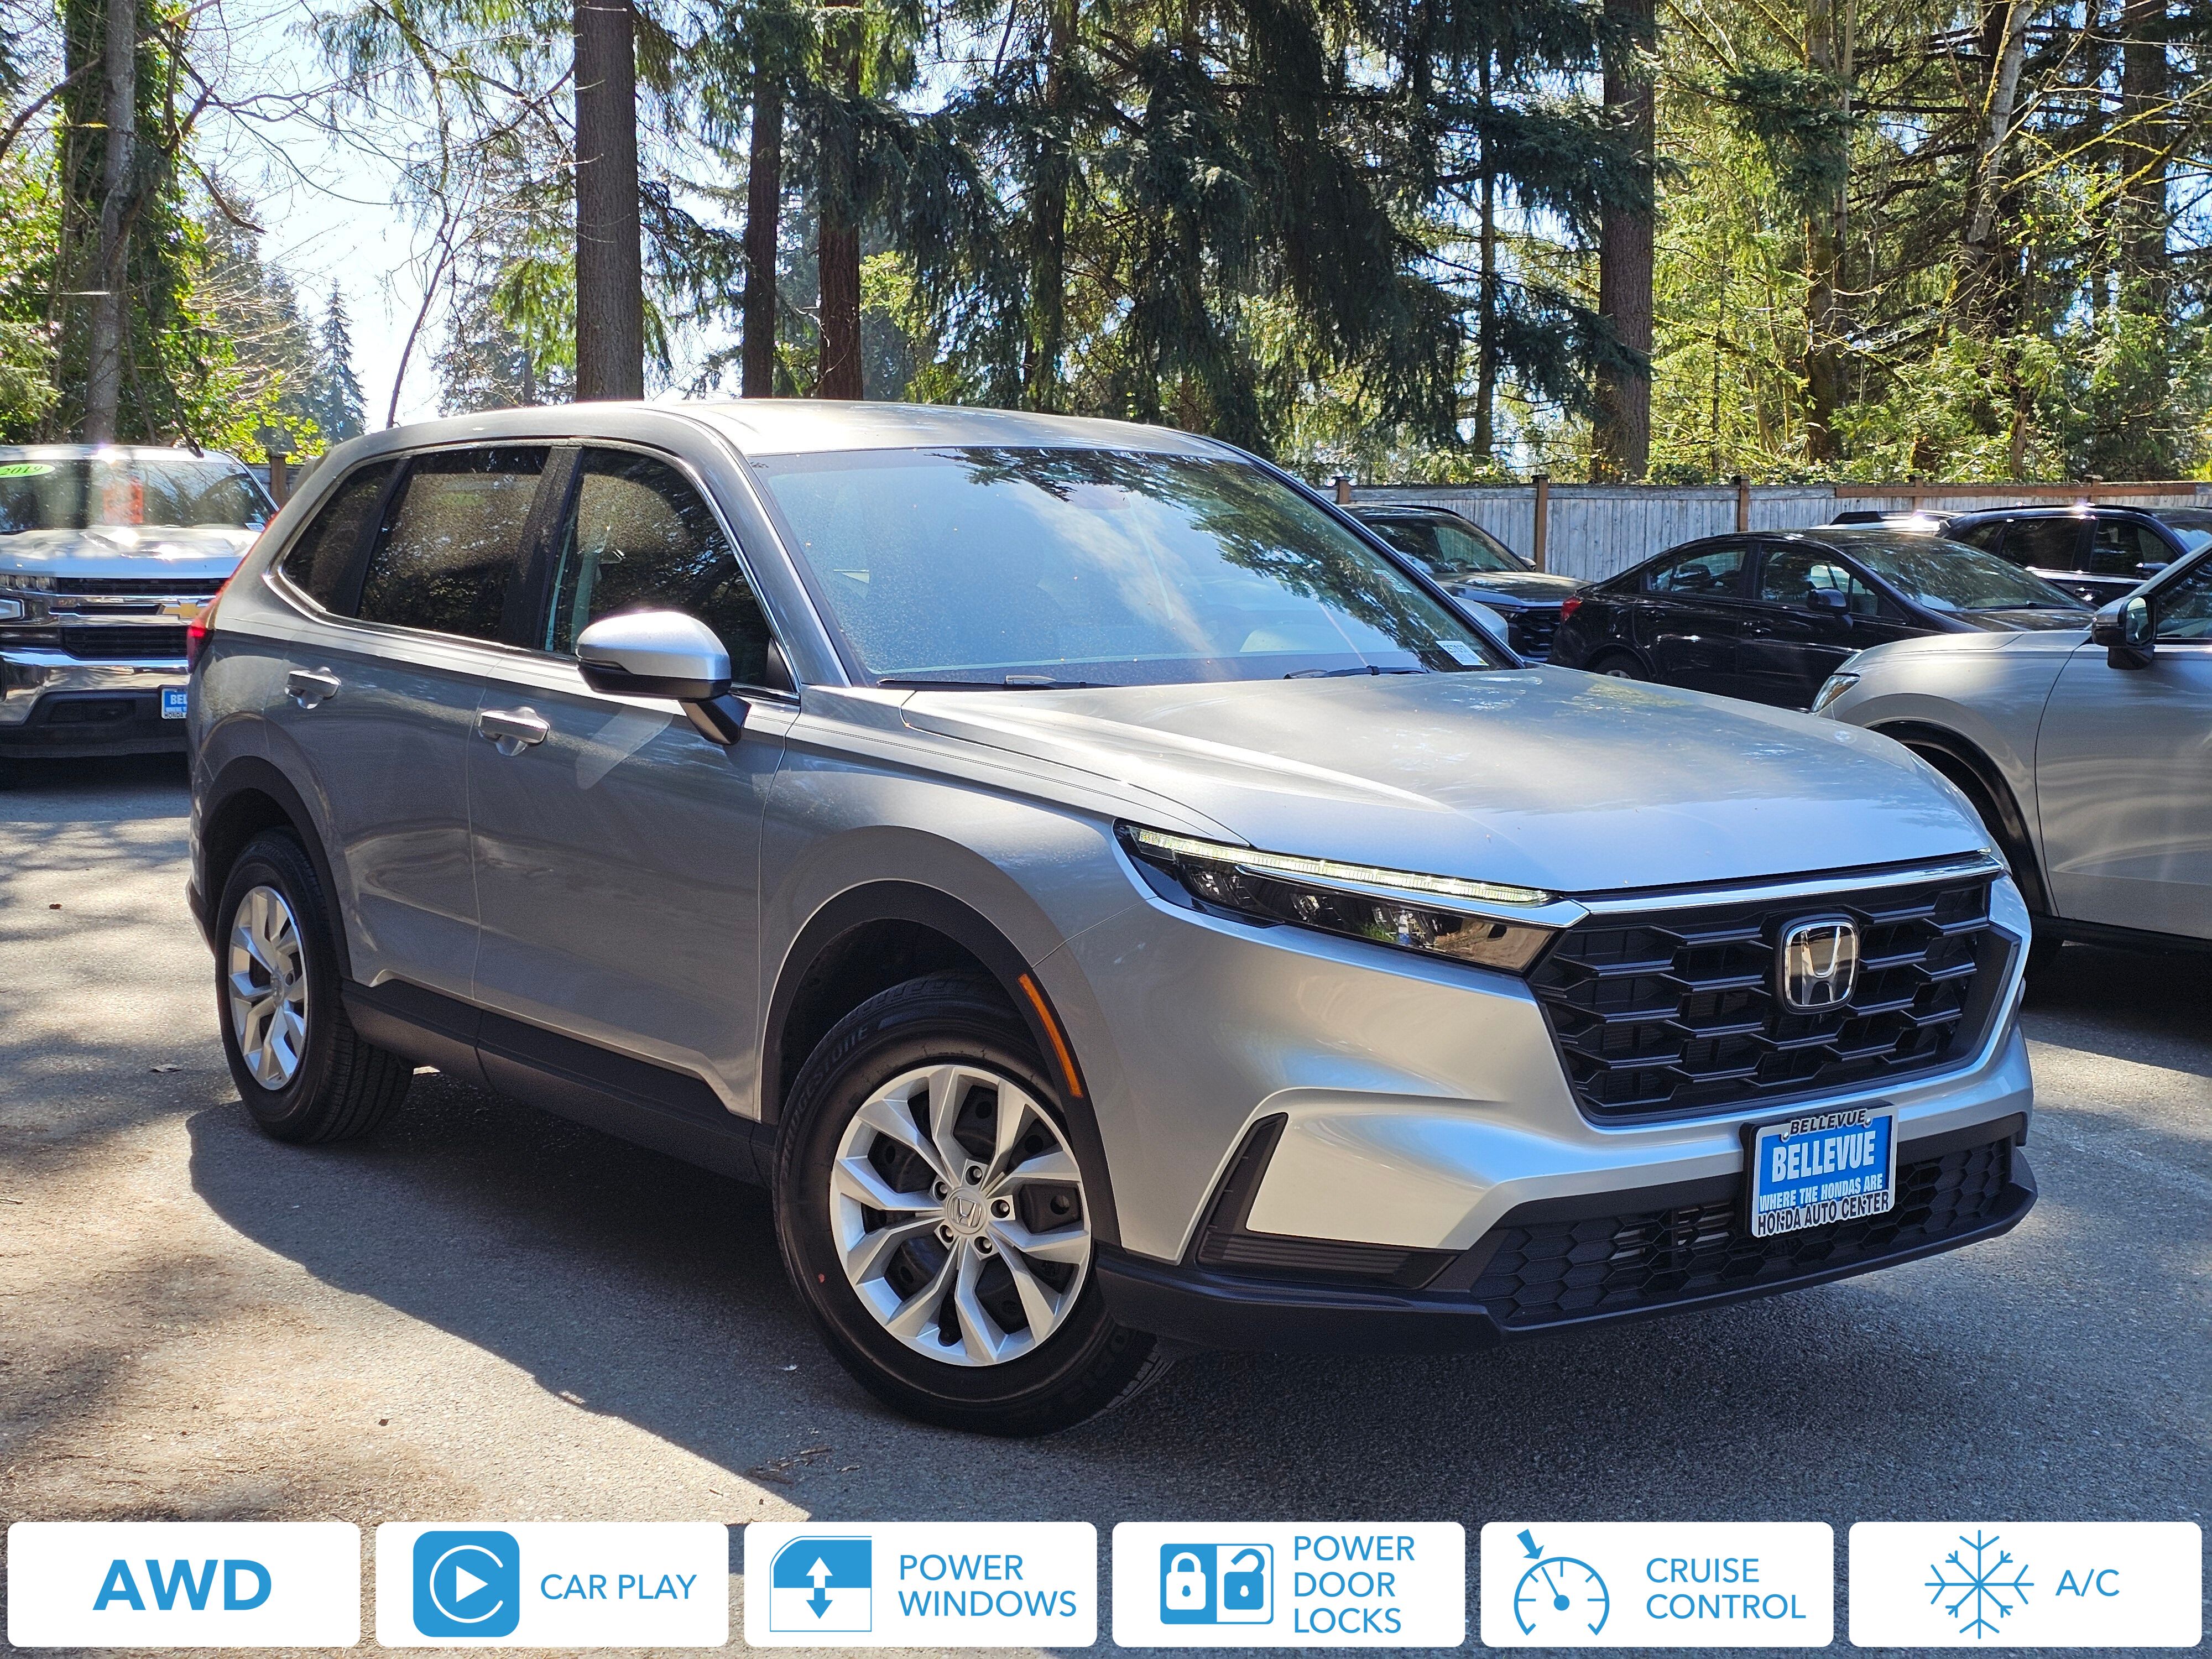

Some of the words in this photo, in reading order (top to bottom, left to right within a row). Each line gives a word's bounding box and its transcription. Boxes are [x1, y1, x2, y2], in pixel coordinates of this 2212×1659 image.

[0, 466, 43, 476] 2019
[1790, 1110, 1867, 1135] BELLEVUE
[1772, 1130, 1876, 1183] BELLEVUE
[1759, 1190, 1797, 1212] WHERE
[1799, 1186, 1818, 1205] THE
[1820, 1179, 1861, 1201] HONDAS
[1864, 1173, 1883, 1192] ARE
[1757, 1208, 1801, 1236] HONDA
[1804, 1200, 1837, 1227] AUTO
[1841, 1191, 1889, 1220] CENTER
